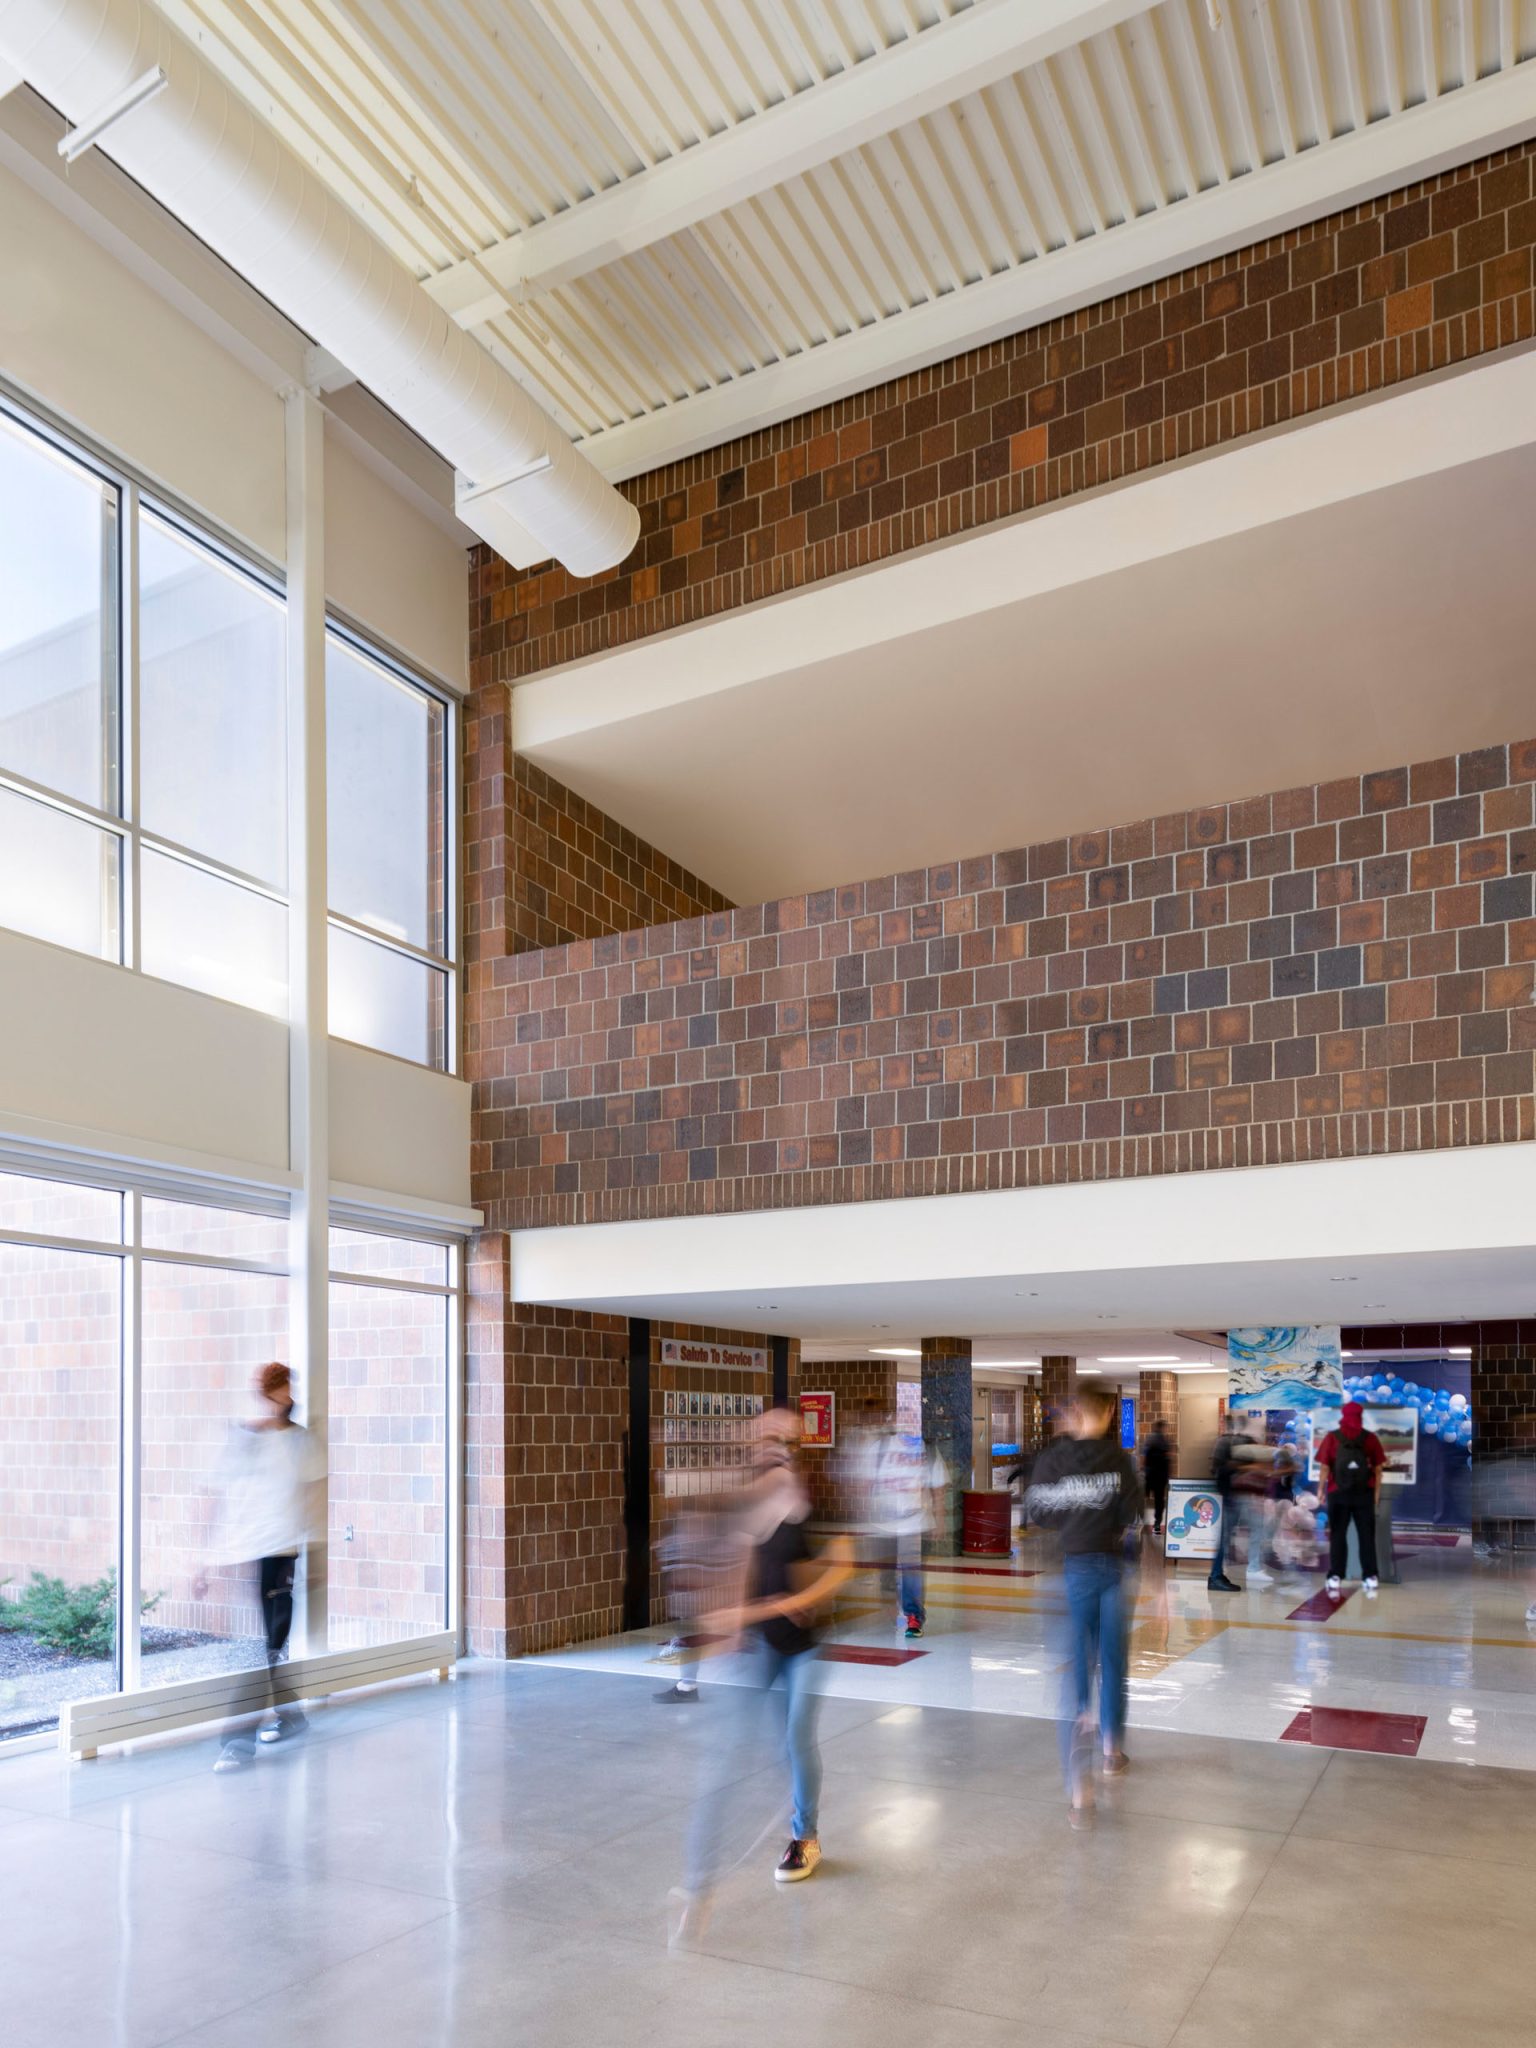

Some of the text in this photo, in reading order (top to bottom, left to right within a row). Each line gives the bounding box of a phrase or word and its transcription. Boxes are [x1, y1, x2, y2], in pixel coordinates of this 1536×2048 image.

[681, 1345, 752, 1366] Salute To Service
